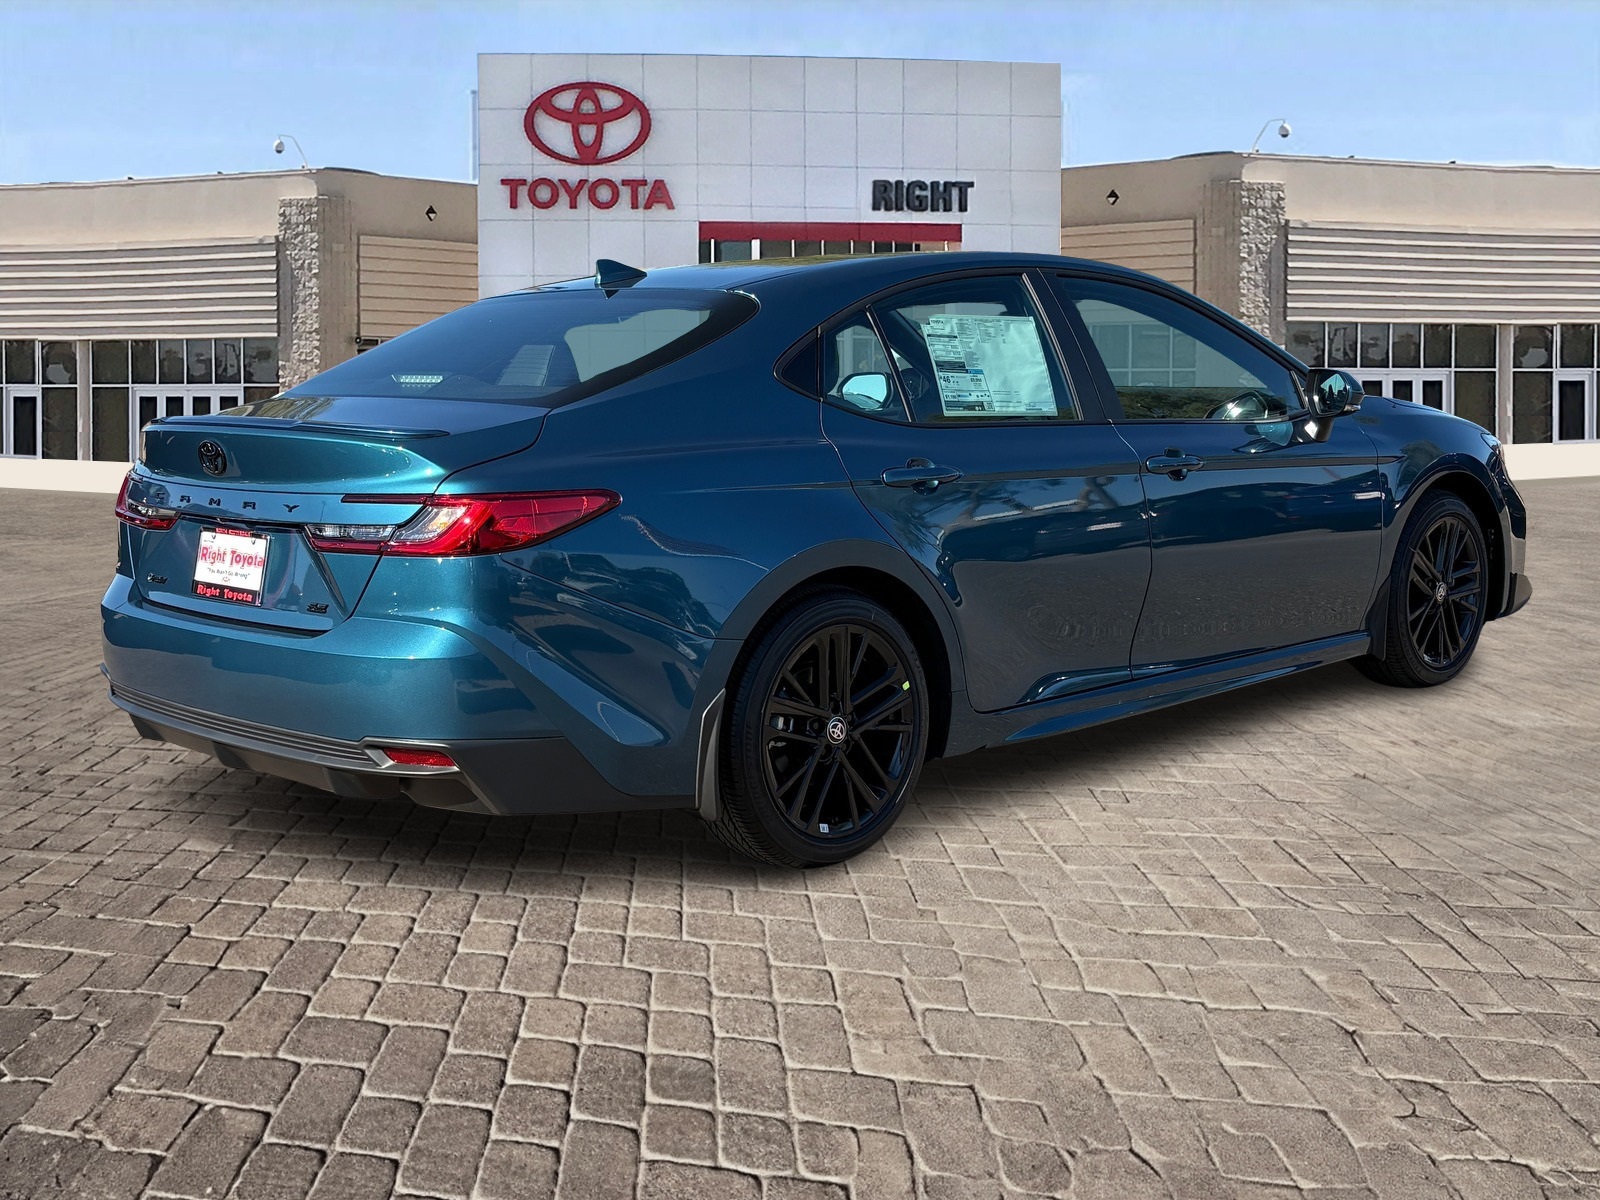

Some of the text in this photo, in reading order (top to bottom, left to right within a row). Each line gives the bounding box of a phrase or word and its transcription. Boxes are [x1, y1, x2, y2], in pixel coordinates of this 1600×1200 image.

[501, 178, 675, 211] TOYOTA
[872, 179, 975, 212] RIGHT
[156, 492, 300, 513] CAMRY
[201, 546, 265, 568] Right Toyota
[196, 584, 253, 602] Right Toyota
